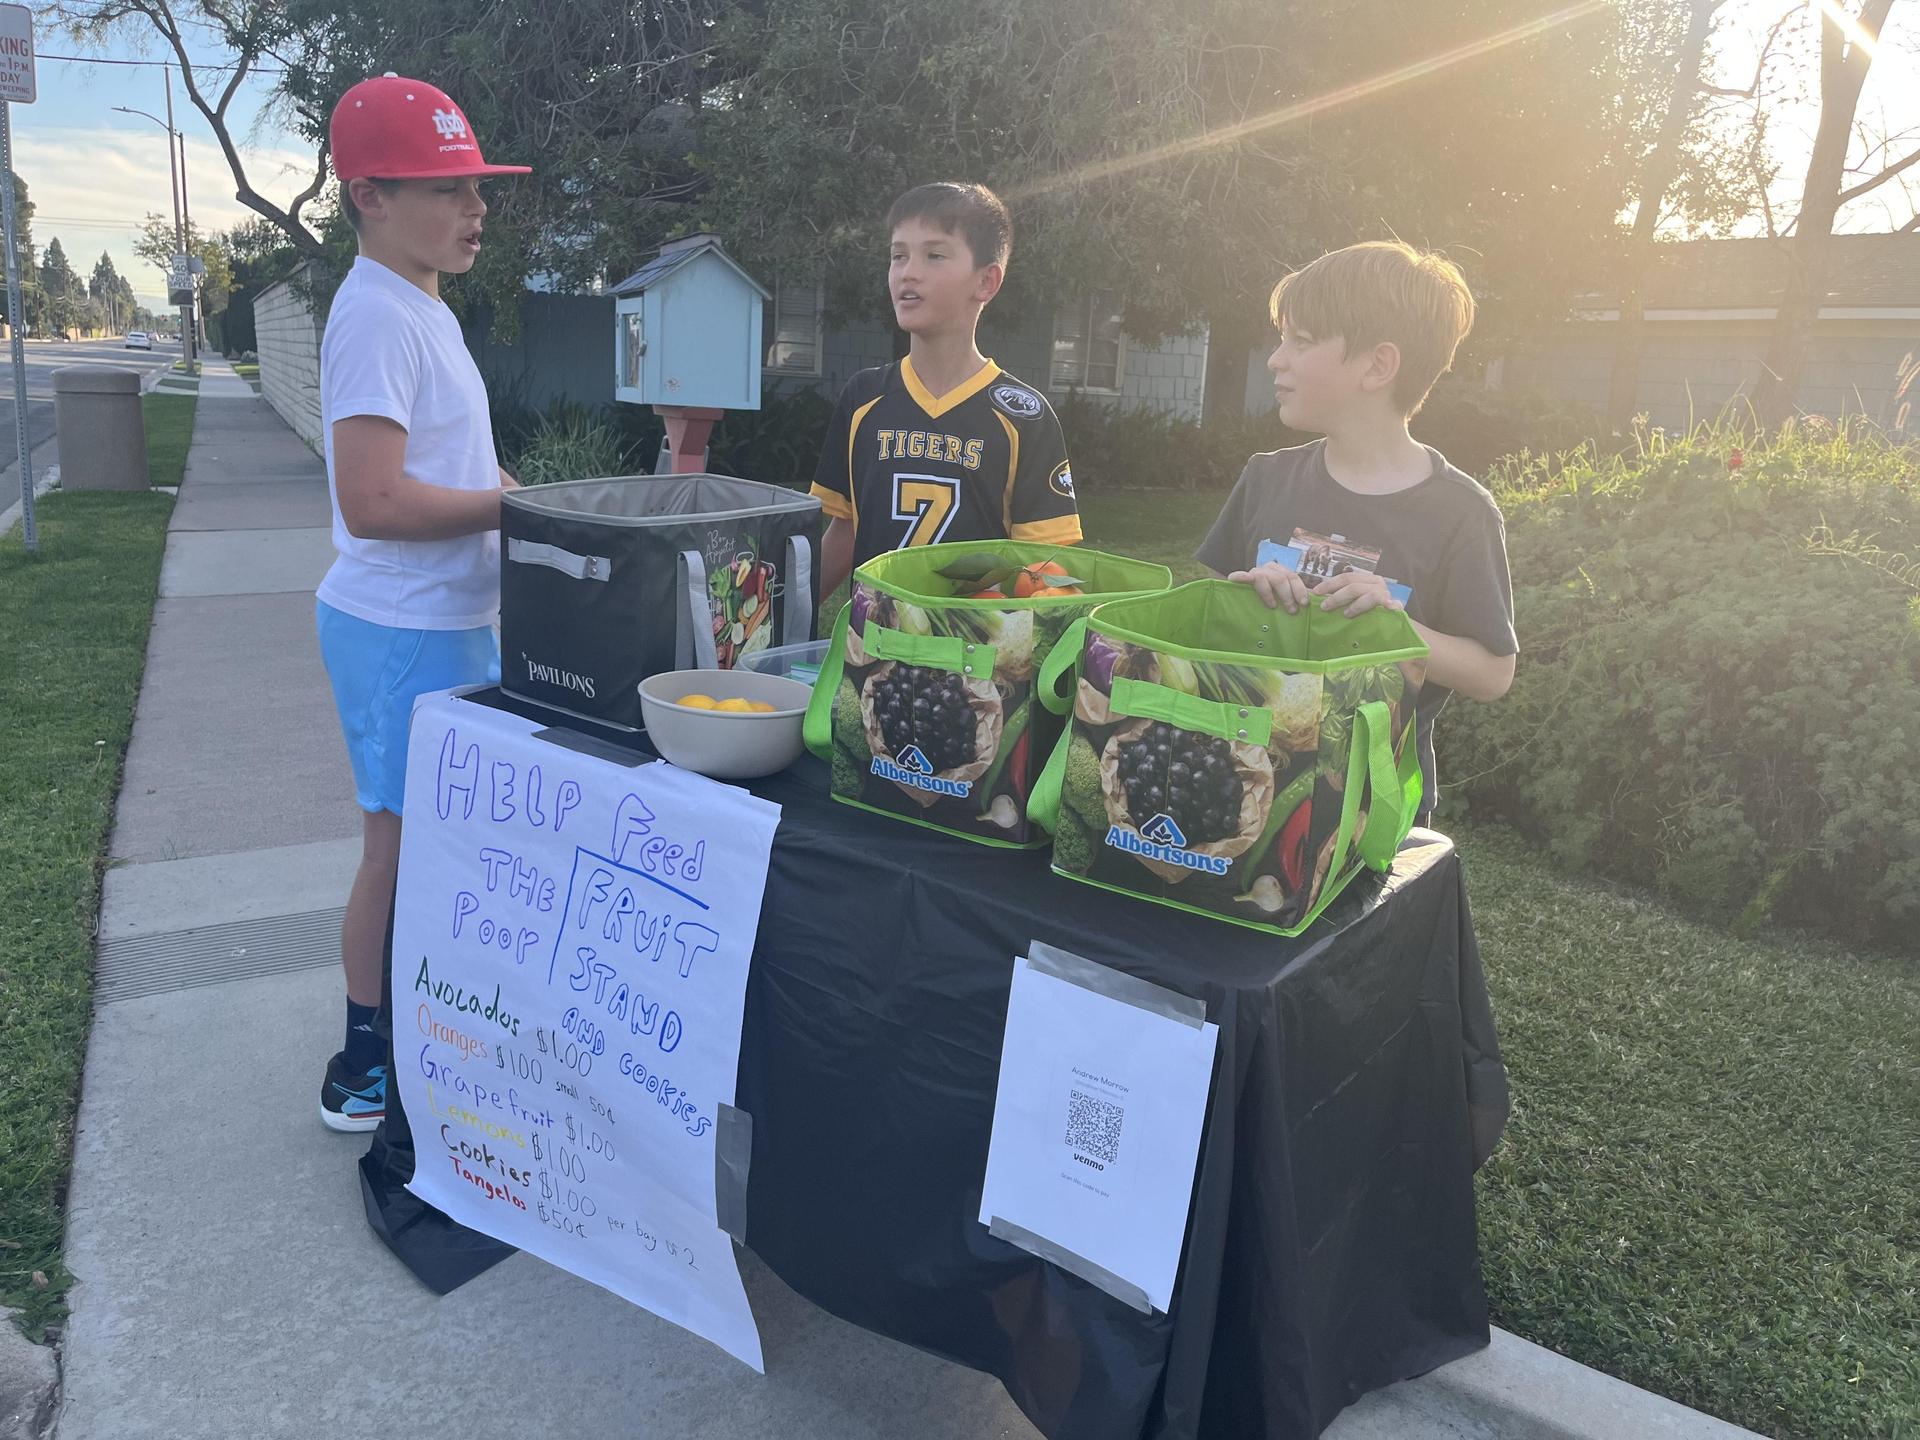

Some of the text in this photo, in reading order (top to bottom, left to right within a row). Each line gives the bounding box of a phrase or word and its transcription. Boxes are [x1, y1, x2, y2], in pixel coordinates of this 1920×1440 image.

[877, 430, 984, 470] TIGERS
[892, 473, 960, 550] 7
[527, 660, 596, 699] PAVILIONS
[437, 728, 705, 881] HELP Feed
[871, 756, 969, 798] Albertsons
[480, 848, 555, 911] THE
[1105, 824, 1230, 875] Albertsons
[415, 955, 592, 1076] Avocados $1.00
[562, 1007, 605, 1056] AND
[570, 947, 682, 1053] STAND
[417, 1003, 488, 1062] Oranges
[420, 1044, 615, 1161] Grapefruit $1.00
[1071, 1067, 1099, 1082] Andrew
[1100, 1077, 1129, 1093] Morrow
[427, 1083, 527, 1148] Lemons
[441, 1124, 532, 1188] Cookies
[1073, 1153, 1104, 1171] venmo
[448, 1155, 527, 1211] Tangelos
[607, 1215, 625, 1232] per
[635, 1219, 657, 1251] bag
[683, 1247, 700, 1271] 2
